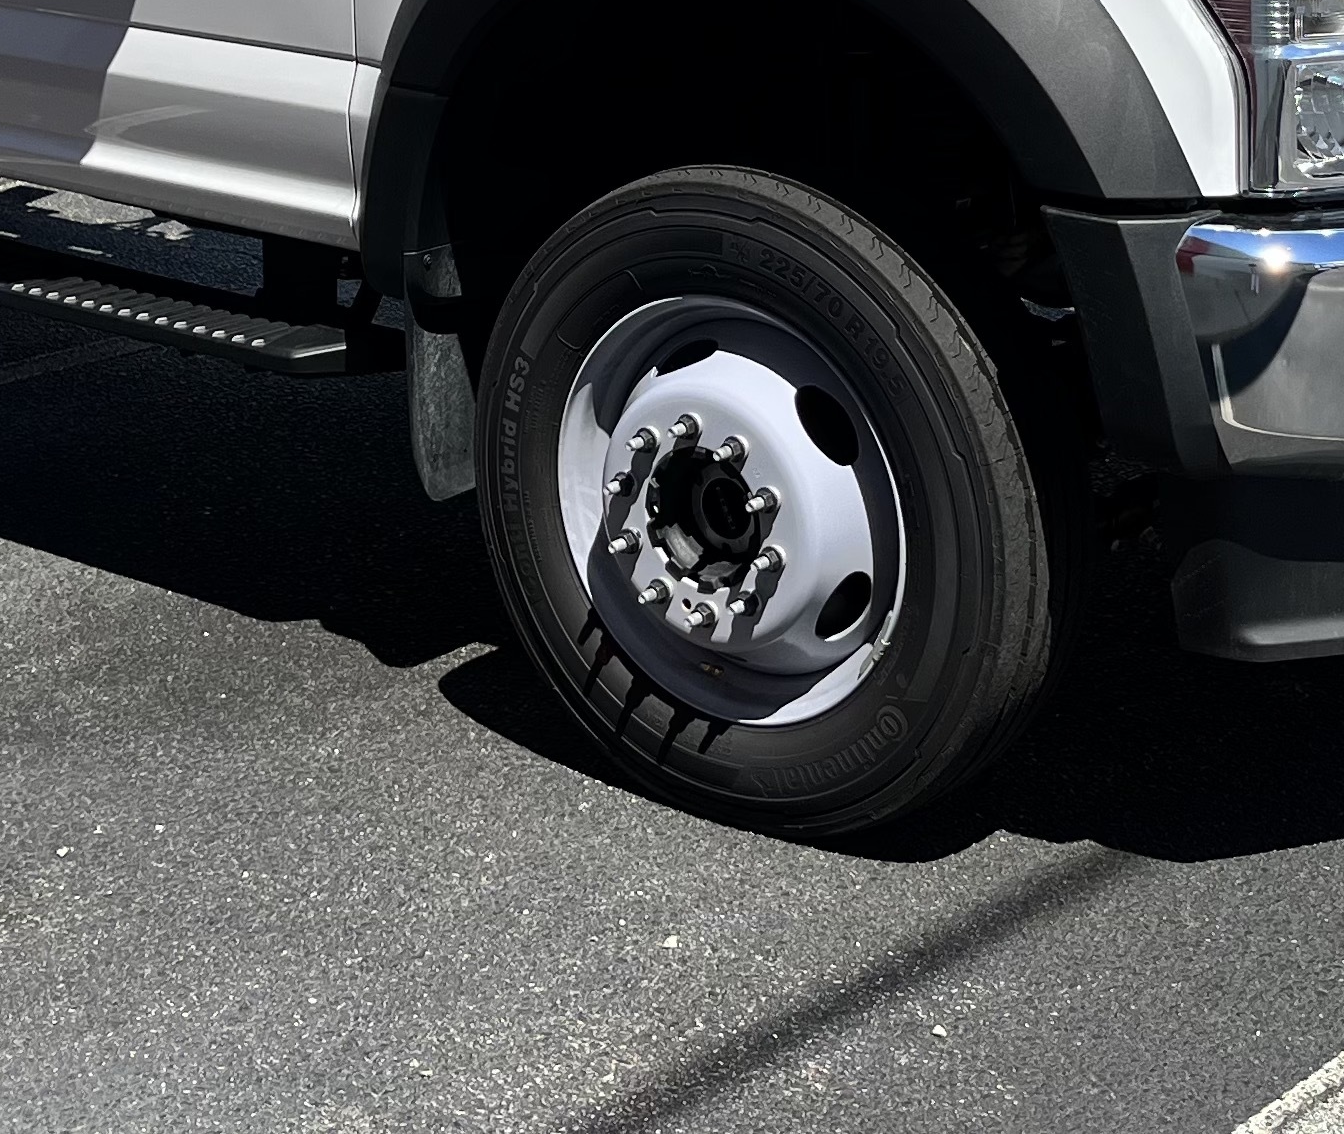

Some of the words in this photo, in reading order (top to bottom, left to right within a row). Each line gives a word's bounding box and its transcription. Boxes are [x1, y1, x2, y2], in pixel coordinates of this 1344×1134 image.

[758, 248, 846, 320] 225/70
[504, 355, 531, 413] HS3
[500, 417, 520, 512] Hybrid
[773, 705, 909, 795] Continental
